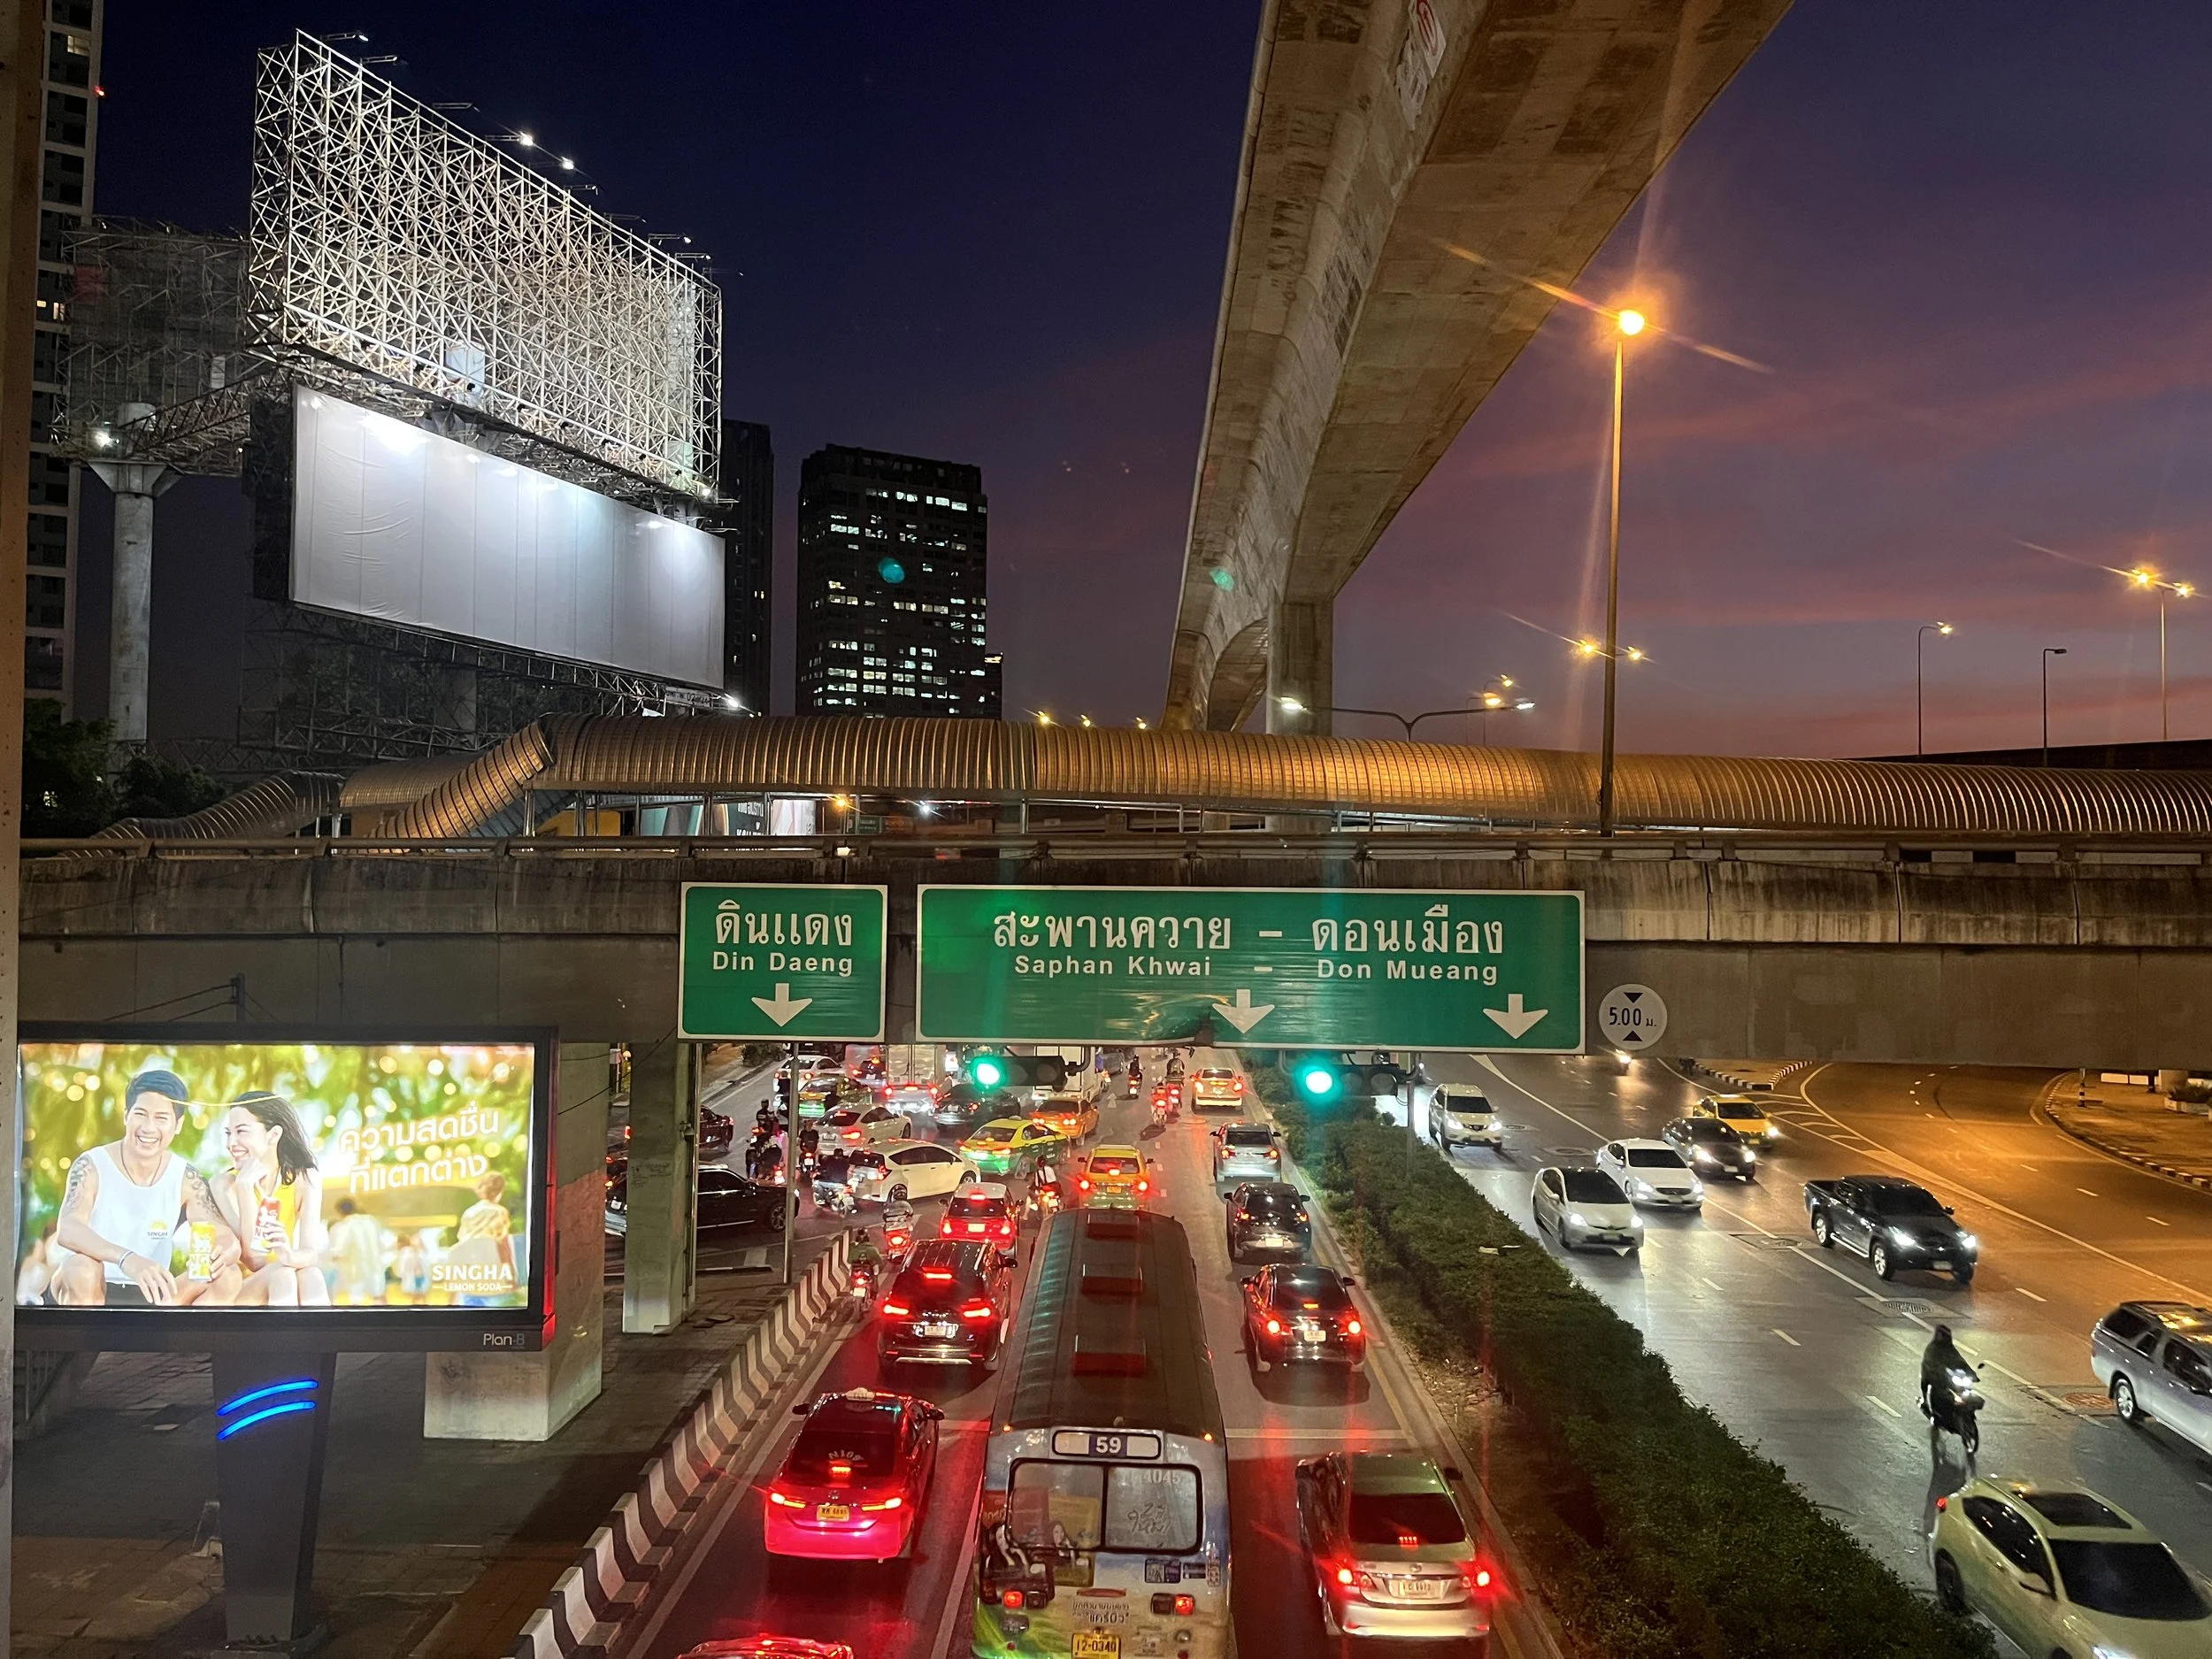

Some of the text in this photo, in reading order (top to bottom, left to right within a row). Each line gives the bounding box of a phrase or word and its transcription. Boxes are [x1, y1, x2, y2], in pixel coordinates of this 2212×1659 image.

[715, 899, 852, 946] ดินแดง
[994, 910, 1232, 950] สะพานควาย
[1312, 903, 1503, 955] ดอนเมือง
[713, 951, 853, 978] Din Daeng
[1015, 955, 1113, 978] Saphan
[1128, 956, 1211, 977] Khwai
[1317, 959, 1371, 979] Don
[1386, 960, 1498, 986] Mueang
[1609, 1006, 1642, 1026] 5.00
[340, 1101, 499, 1154] ความสดชื่น
[349, 1150, 488, 1194] ที่แตกต่าง
[432, 1264, 513, 1281] SINGHA
[443, 1283, 503, 1292] LEMON SODA
[1095, 1438, 1122, 1454] 59
